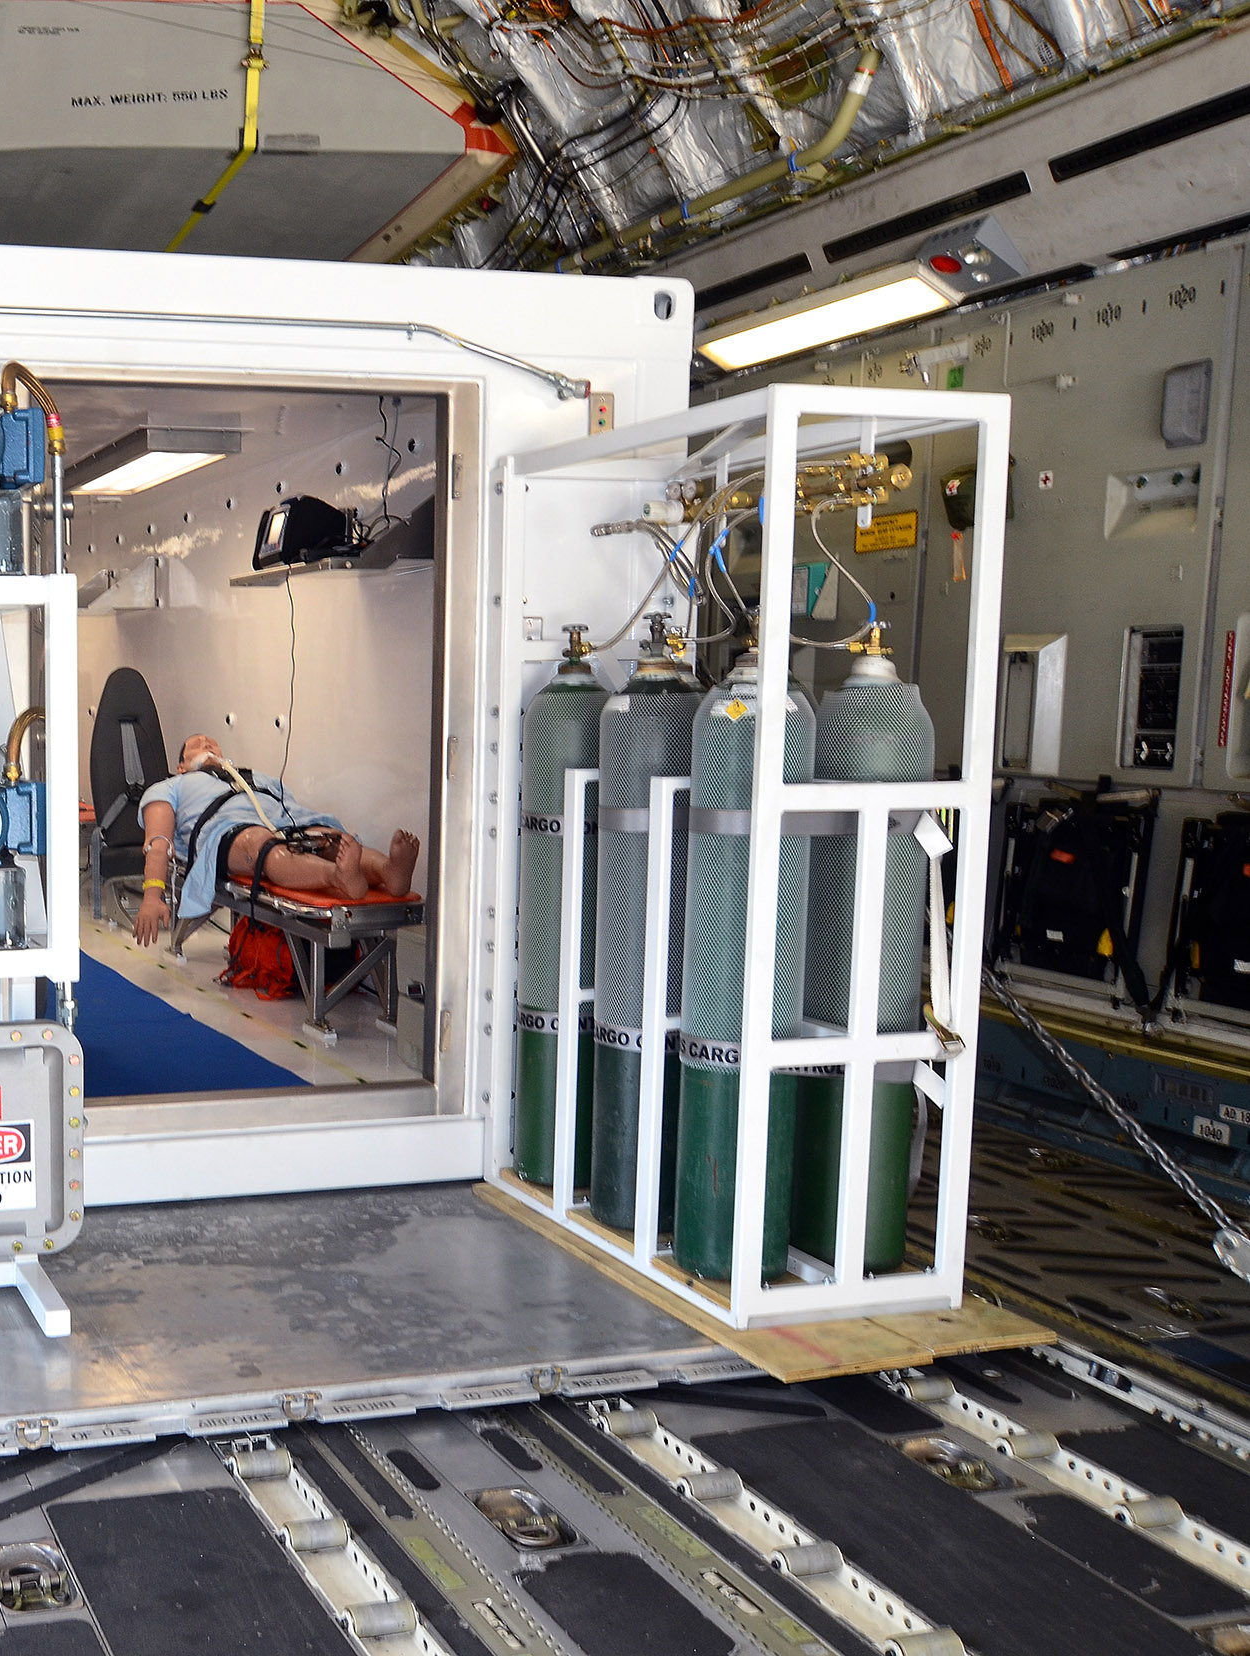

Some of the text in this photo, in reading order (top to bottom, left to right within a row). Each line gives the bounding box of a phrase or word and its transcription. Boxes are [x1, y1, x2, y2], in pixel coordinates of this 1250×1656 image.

[71, 88, 229, 107] MAX. WEIGHT: 550 LBS
[523, 815, 561, 832] ARGO
[689, 1041, 740, 1064] CARG
[1223, 1106, 1236, 1119] AD
[1199, 1124, 1223, 1141] 1040
[71, 1430, 91, 1440] OF
[333, 1400, 397, 1414] RETURN
[490, 1387, 519, 1399] THE
